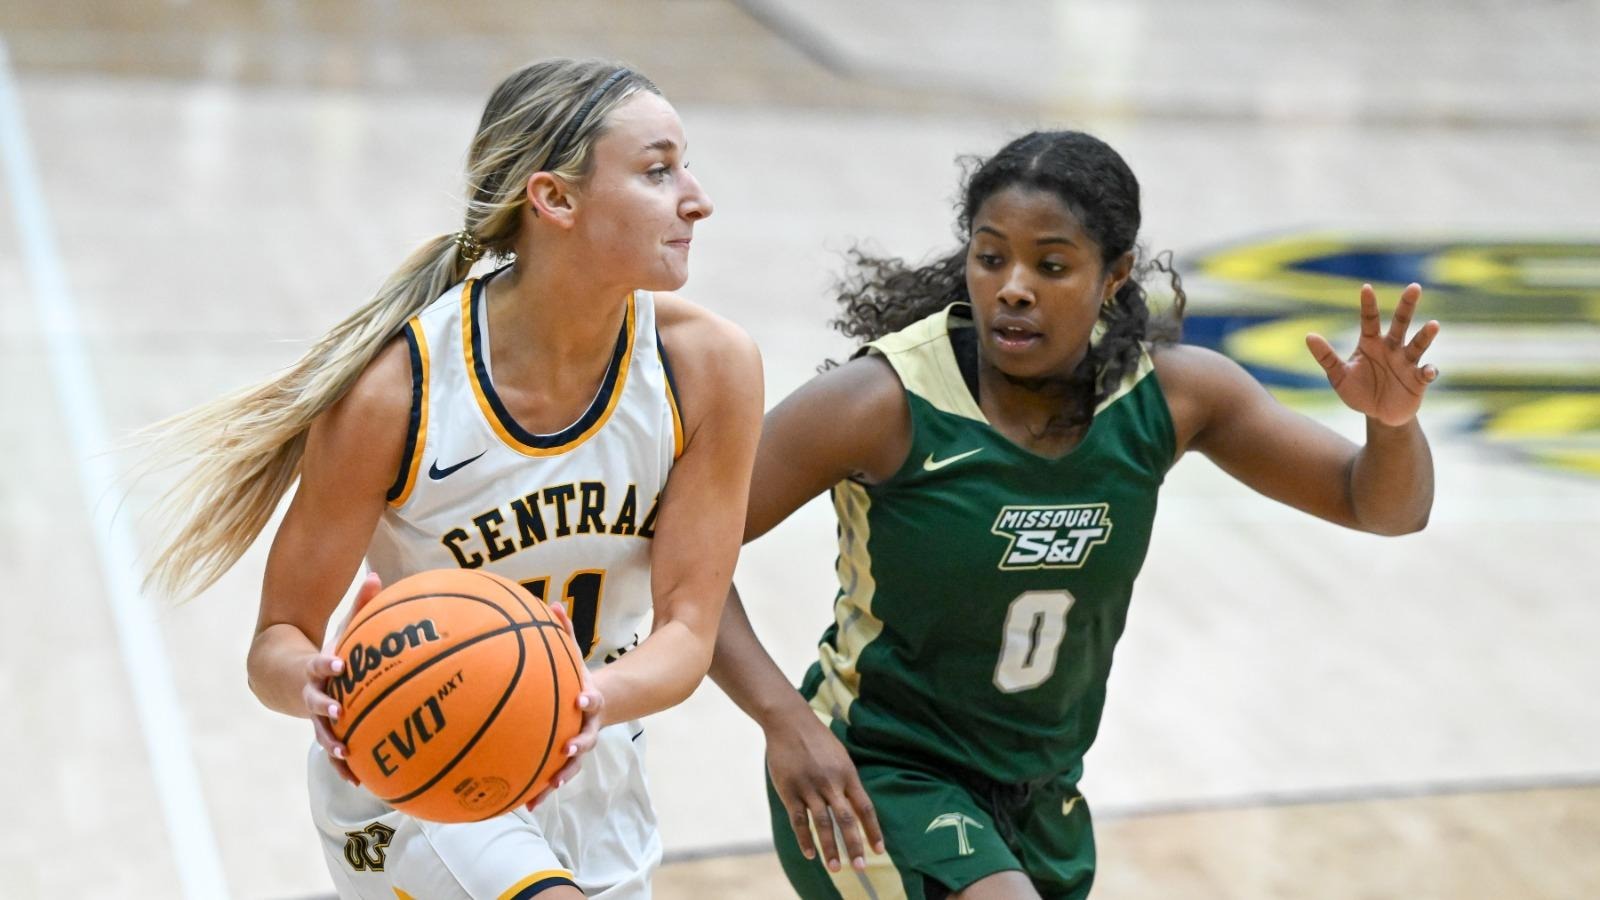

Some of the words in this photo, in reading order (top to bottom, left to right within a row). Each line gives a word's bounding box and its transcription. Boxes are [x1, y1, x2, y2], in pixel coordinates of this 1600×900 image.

[1000, 509, 1102, 529] MISSOURI
[1007, 528, 1104, 564] S&T
[992, 589, 1076, 694] 0
[437, 669, 464, 701] NXT
